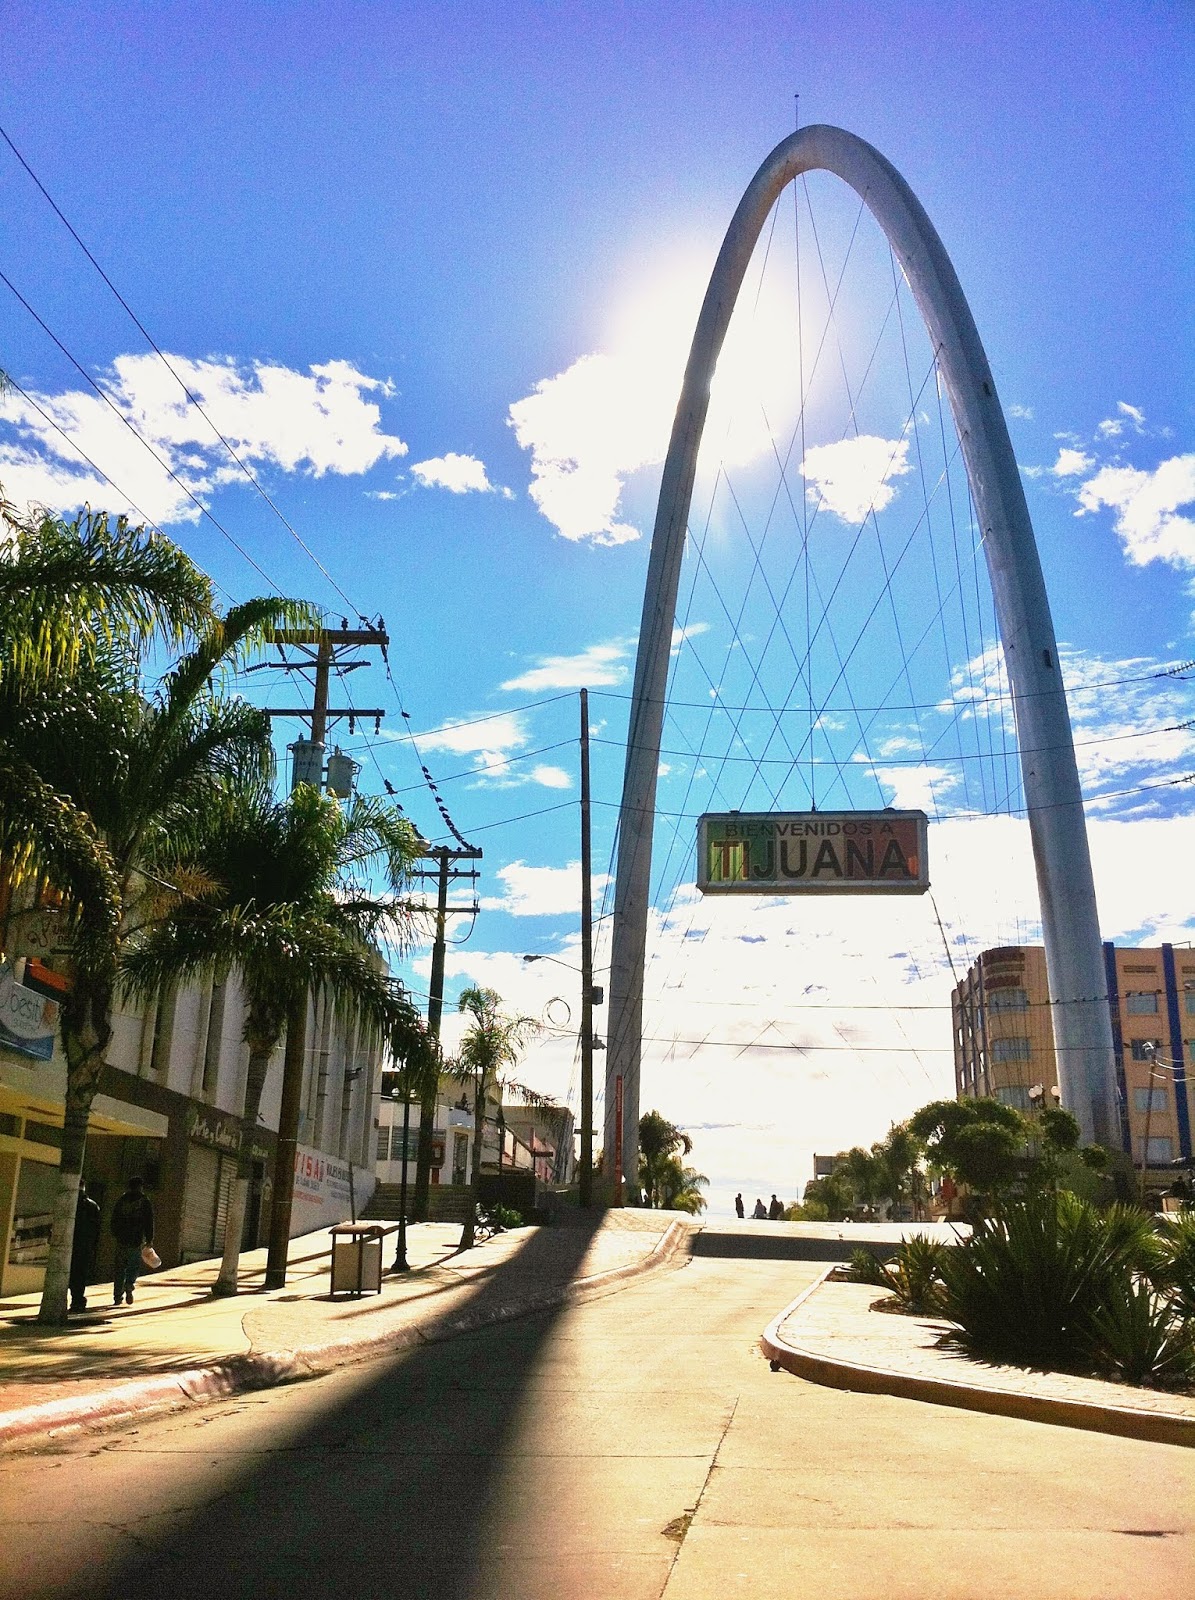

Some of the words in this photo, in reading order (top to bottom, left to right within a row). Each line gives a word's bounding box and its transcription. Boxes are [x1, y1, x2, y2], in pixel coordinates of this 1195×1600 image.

[724, 822, 873, 837] BIENVENIDOS
[879, 822, 894, 835] A
[712, 839, 913, 879] TIJUANA
